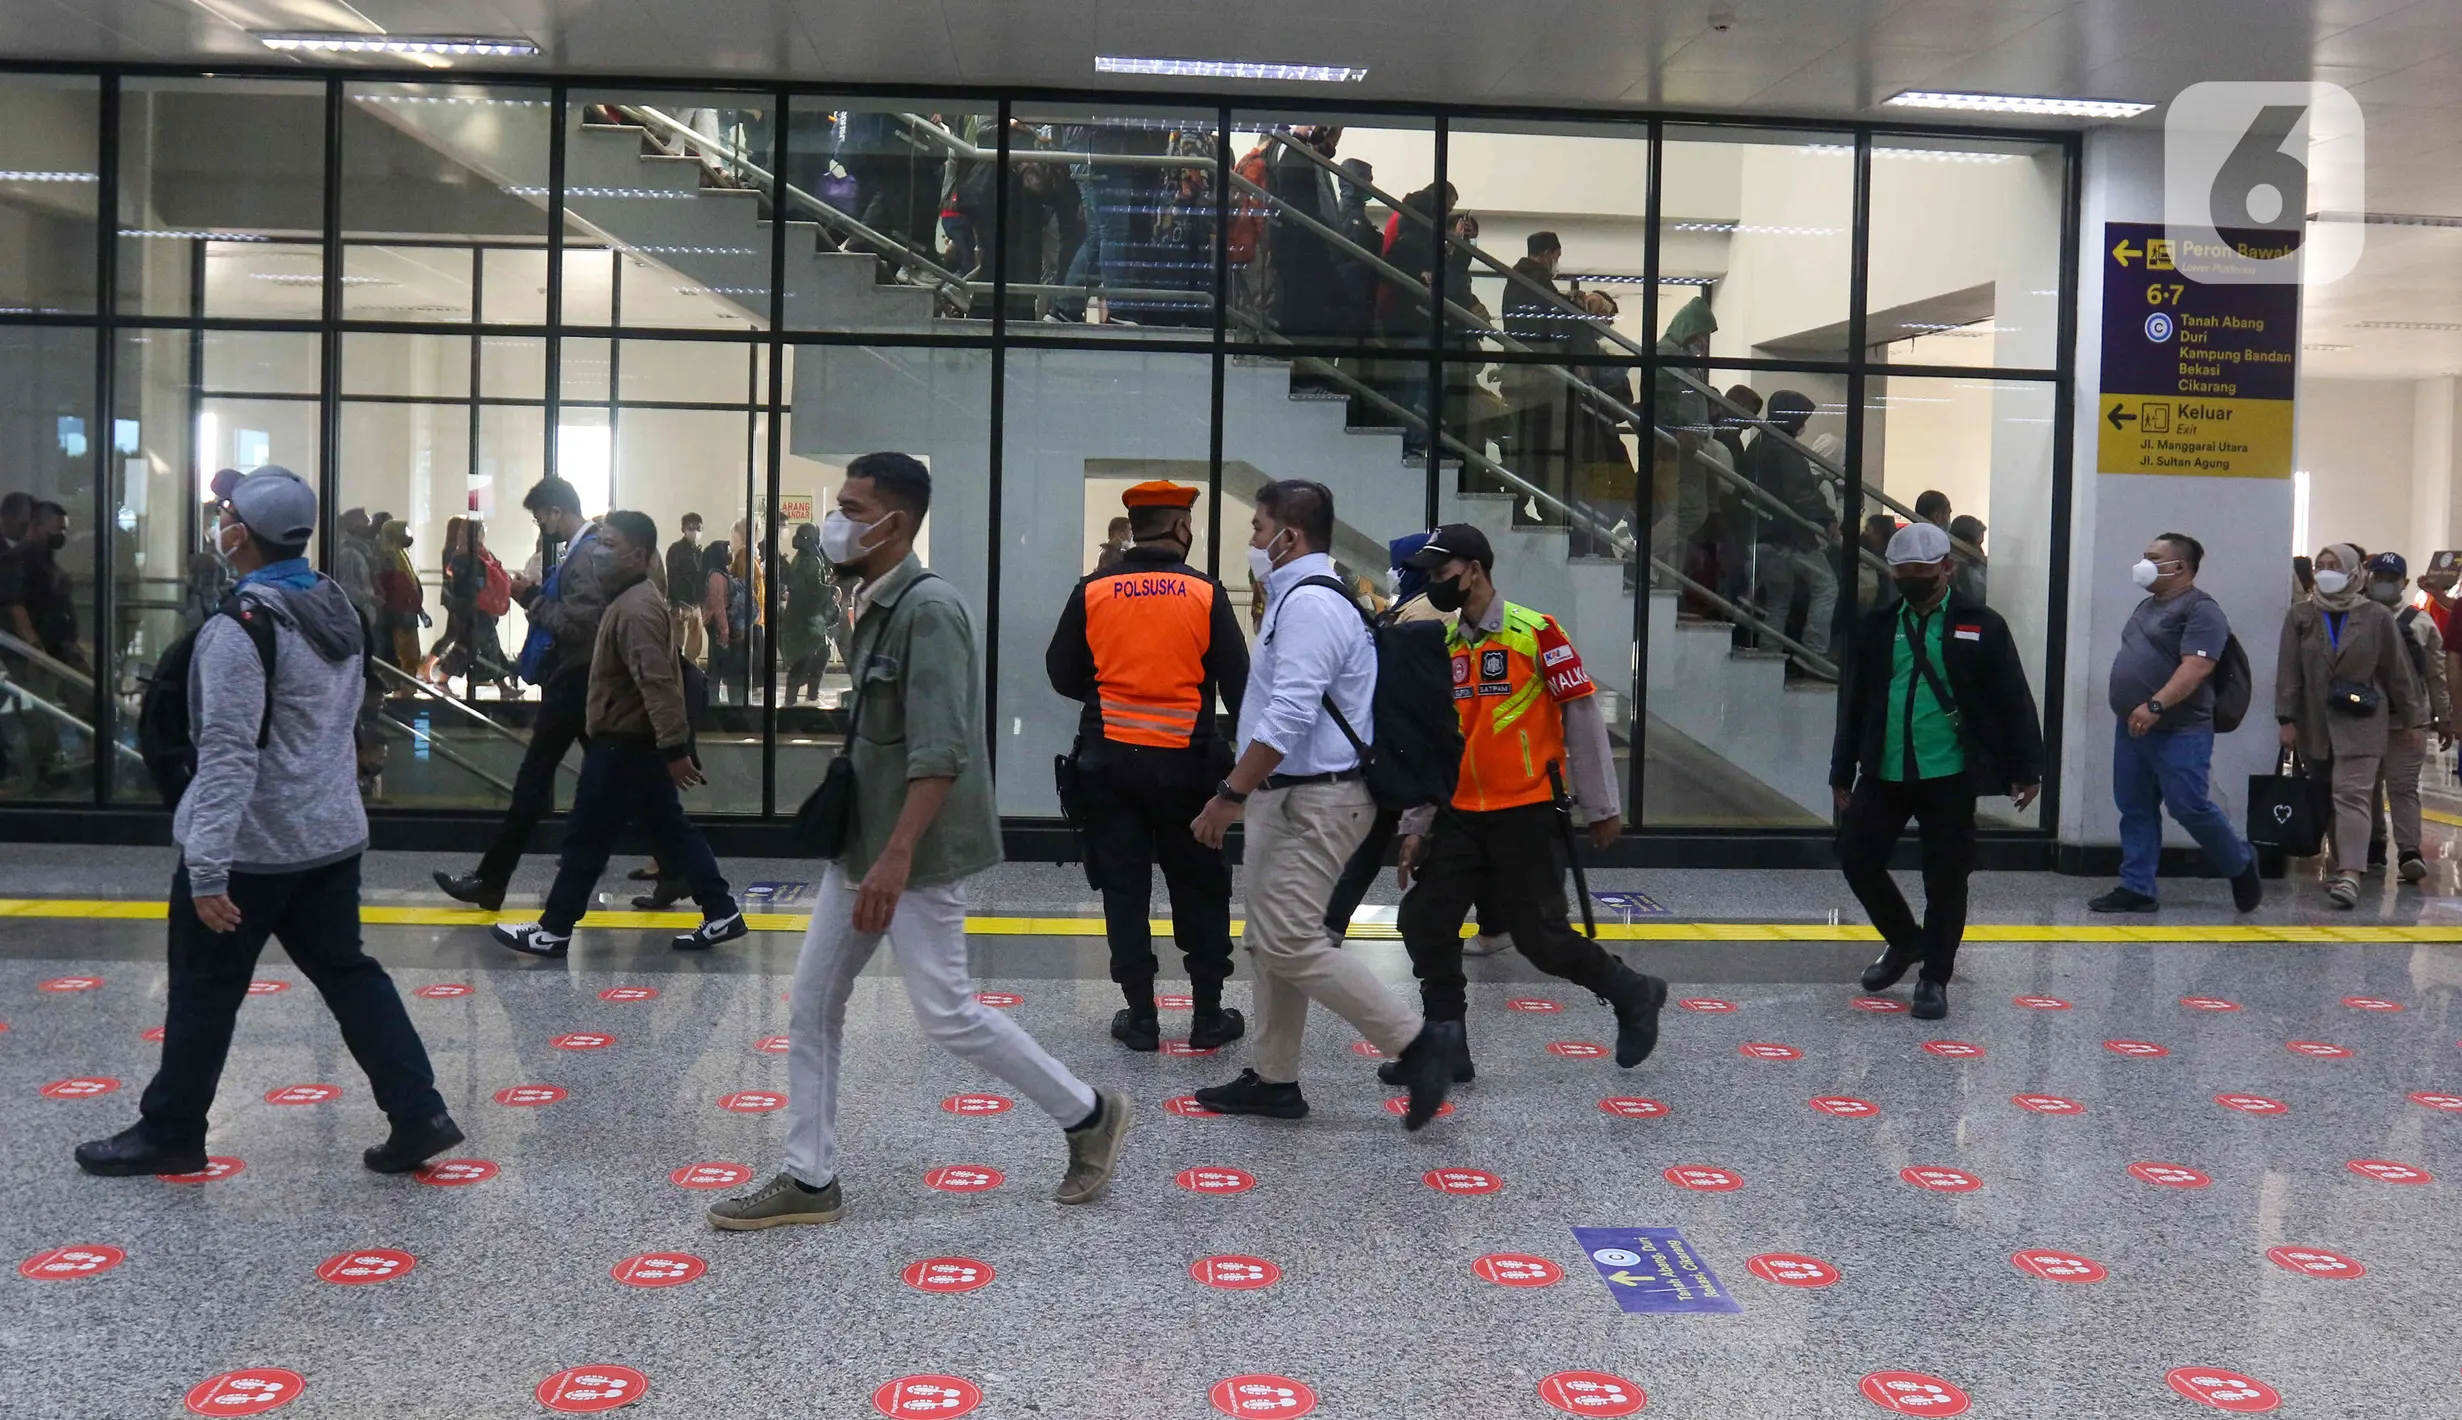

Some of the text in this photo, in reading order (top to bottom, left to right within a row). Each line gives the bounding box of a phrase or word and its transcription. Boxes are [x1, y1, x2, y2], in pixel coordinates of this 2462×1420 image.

[2182, 240, 2295, 261] Peron Bawah
[2154, 322, 2164, 334] C
[2180, 313, 2265, 331] Tanah Abang
[2180, 331, 2208, 344] Duri
[2179, 347, 2292, 363] Kampung Bandan
[2179, 363, 2220, 376] Bekasi
[2178, 379, 2237, 396] Cikarang
[2178, 403, 2234, 421] Keluar
[2176, 423, 2198, 435] Exit
[2140, 439, 2248, 453] Jl. Manggarai Utara
[2140, 455, 2230, 470] Jl. Sultan Agung
[1113, 578, 1187, 599] POLSUSKA
[1667, 1240, 1699, 1271] Cikarang
[1666, 1278, 1694, 1301] Tanah
